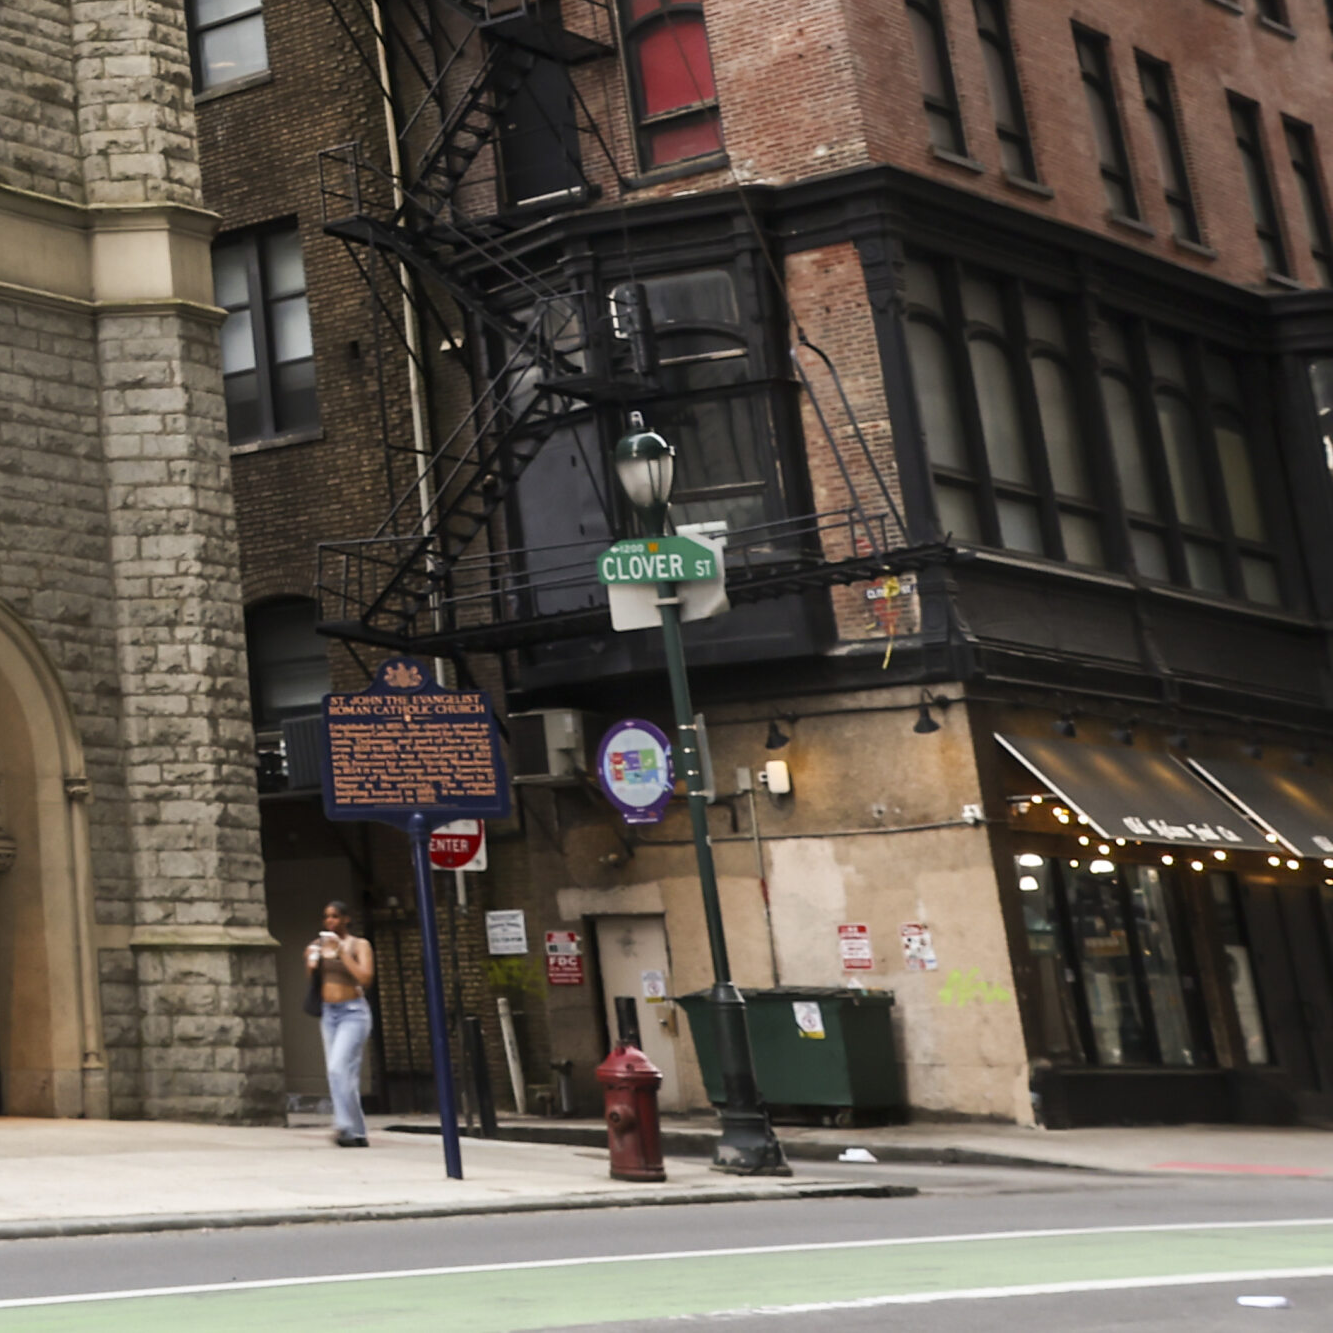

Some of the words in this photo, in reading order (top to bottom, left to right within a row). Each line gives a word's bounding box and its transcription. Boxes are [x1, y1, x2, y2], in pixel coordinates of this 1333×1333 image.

[619, 544, 645, 554] 1200
[647, 542, 659, 553] W
[602, 554, 684, 580] CLOVER
[694, 560, 712, 577] ST
[349, 696, 383, 705] JOHN
[386, 696, 408, 705] THE
[413, 695, 480, 704] EVANGELIST
[329, 706, 371, 714] ROMAN
[374, 705, 432, 714] CATHOLIC
[435, 704, 484, 713] CHURCH
[429, 838, 470, 853] ENTER
